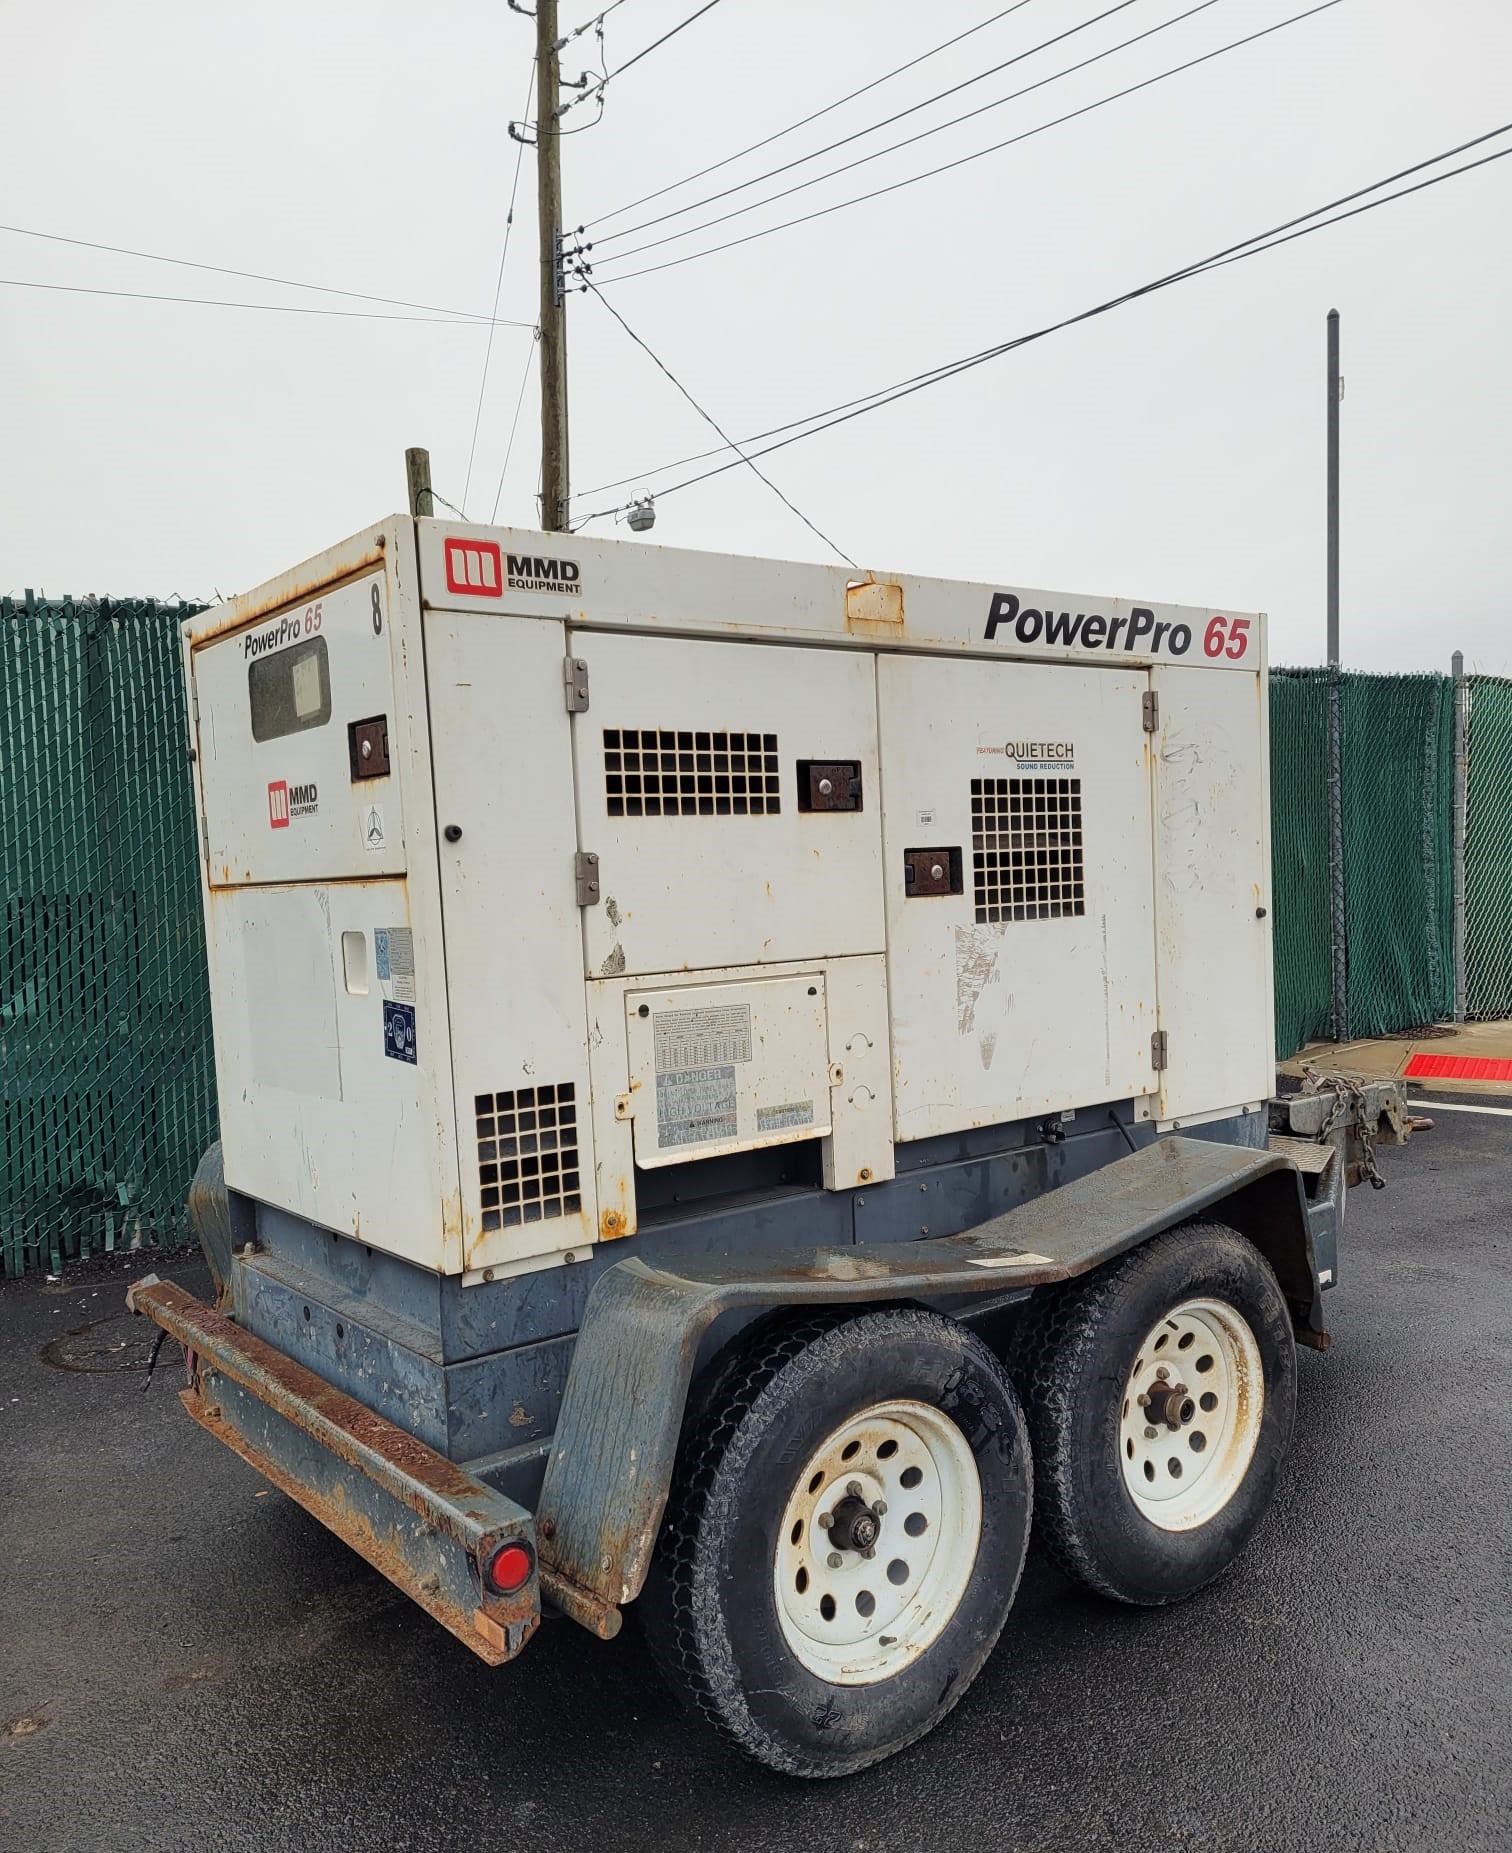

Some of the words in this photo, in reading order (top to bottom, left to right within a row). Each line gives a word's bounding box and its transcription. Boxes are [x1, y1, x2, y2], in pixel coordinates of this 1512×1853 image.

[506, 555, 579, 581] MMD
[508, 578, 581, 593] EQUIPMENT
[371, 582, 382, 635] 8
[244, 617, 301, 659] PowerPro
[304, 602, 322, 634] 65
[984, 592, 1192, 656] PowerPro
[1203, 616, 1251, 660] 65
[1005, 742, 1074, 762] QUIETECH
[289, 783, 317, 806] MMD
[290, 803, 319, 817] EQUIPMENT
[676, 1069, 721, 1085] DANGER
[697, 1116, 723, 1126] WARNING
